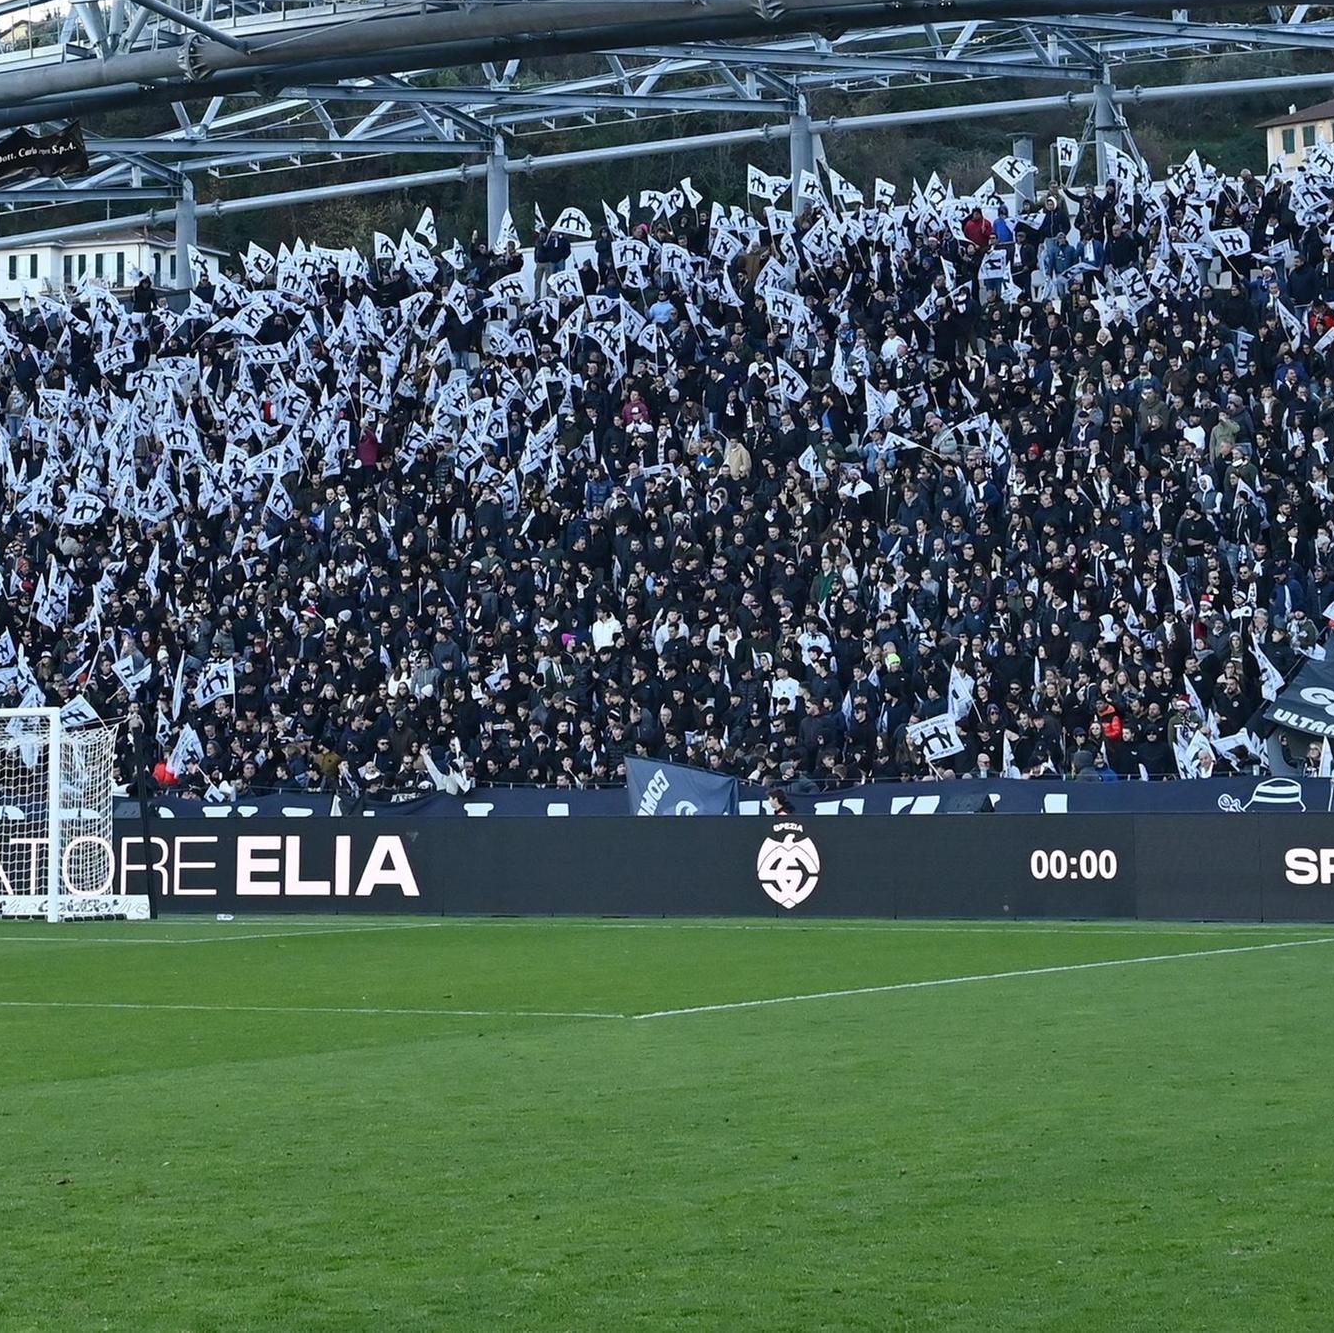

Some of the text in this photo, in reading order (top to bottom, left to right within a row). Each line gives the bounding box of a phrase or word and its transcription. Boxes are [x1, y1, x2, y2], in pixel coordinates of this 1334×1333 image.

[51, 142, 76, 155] S.p.A.
[237, 836, 420, 896] ELIA
[1031, 850, 1117, 880] 00:00
